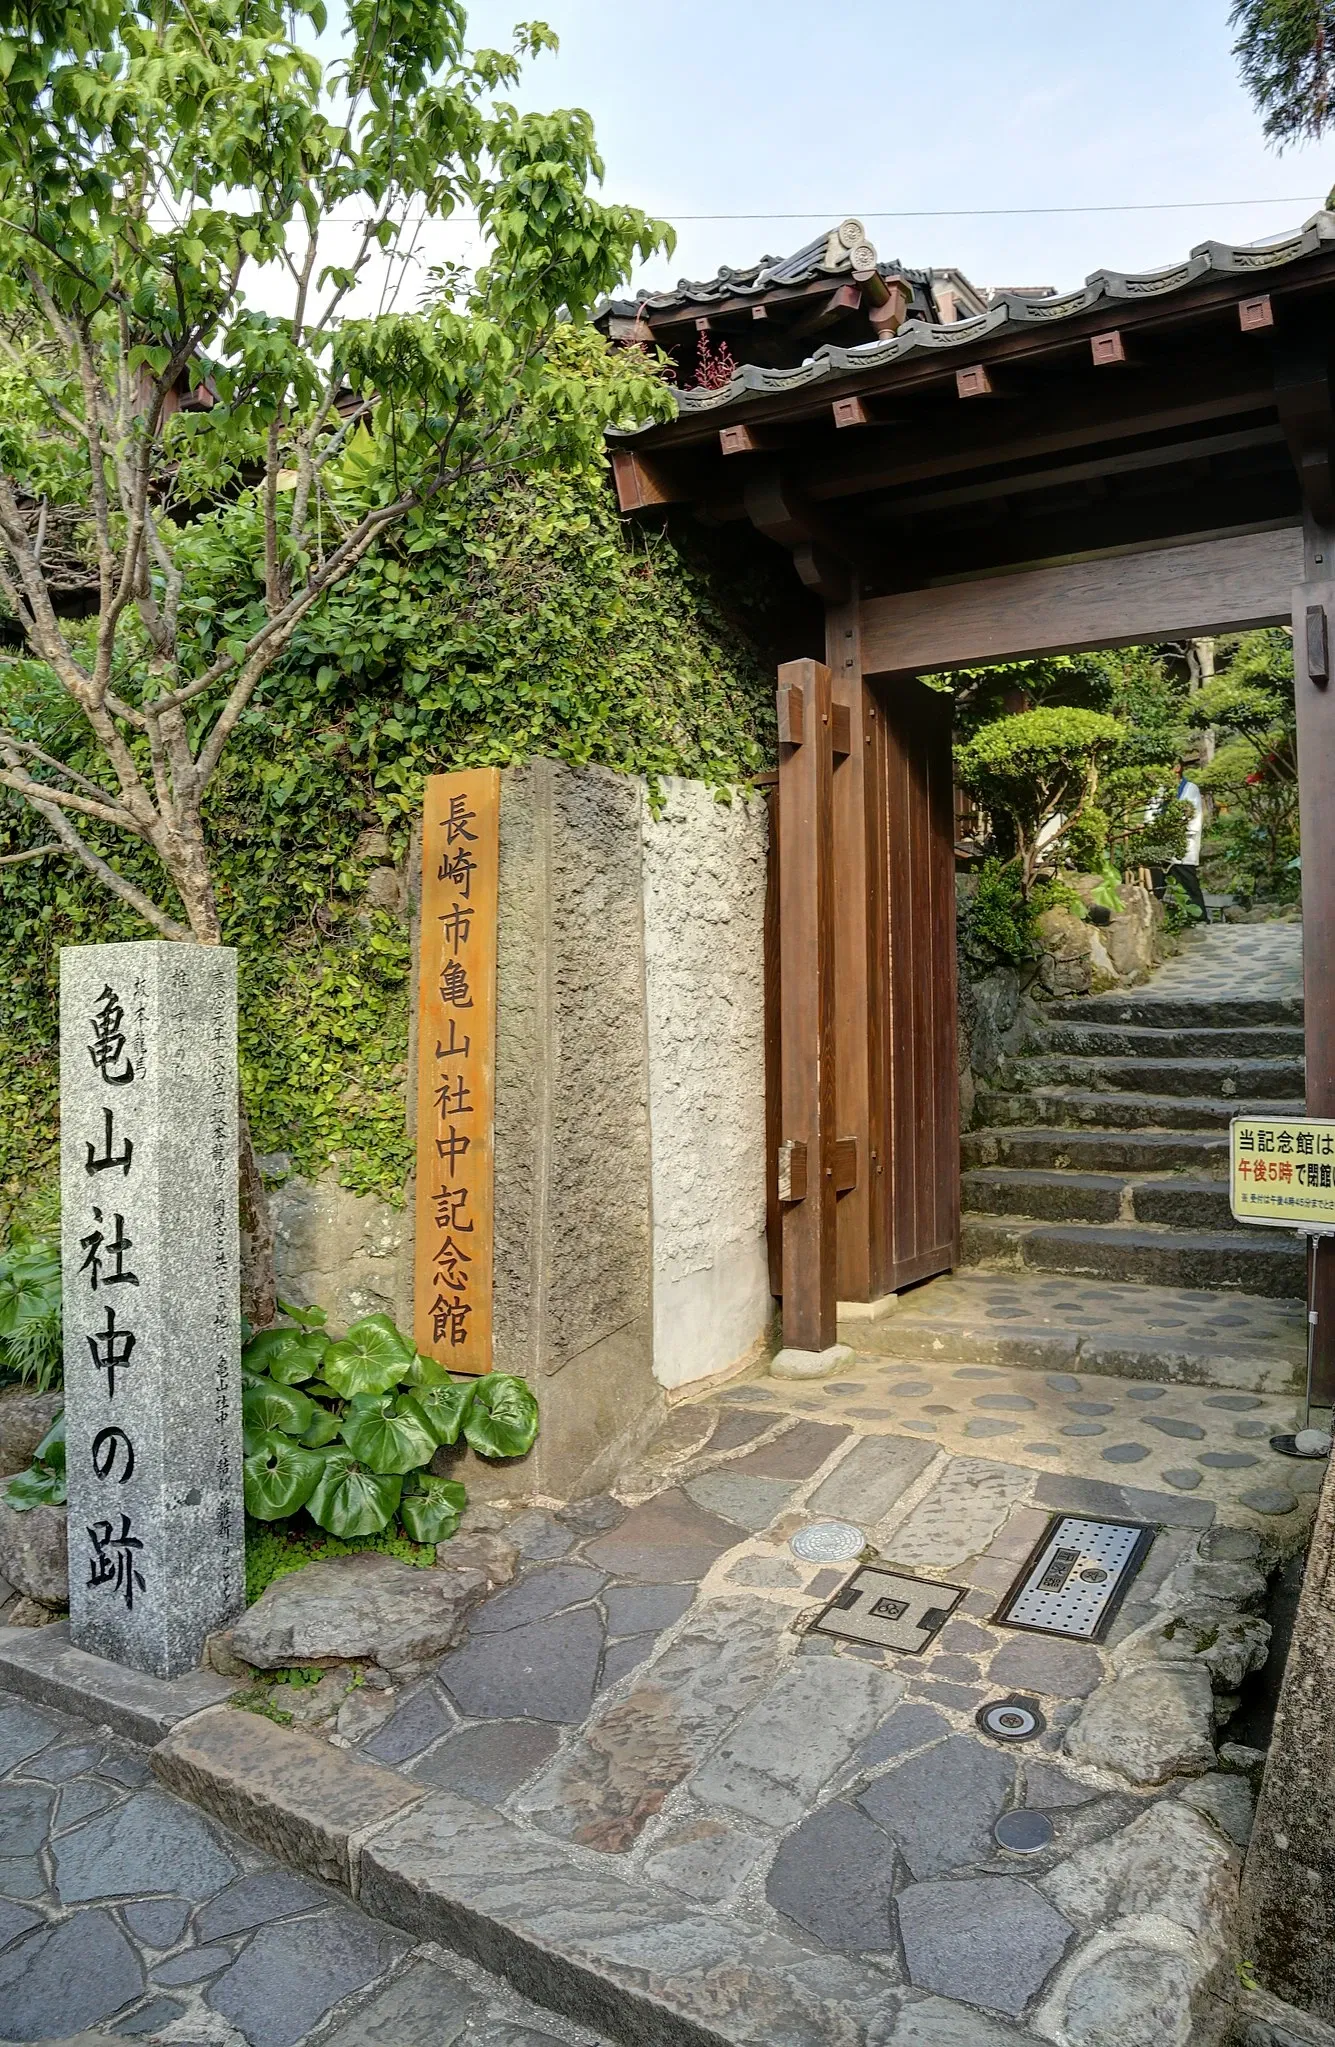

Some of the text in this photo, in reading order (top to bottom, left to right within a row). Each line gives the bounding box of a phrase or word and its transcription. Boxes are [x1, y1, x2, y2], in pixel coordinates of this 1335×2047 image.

[78, 982, 147, 1612] 亀山社中の跡
[427, 793, 479, 1348] 長崎市亀山社中記念館
[1239, 1129, 1334, 1155] 当記念館は
